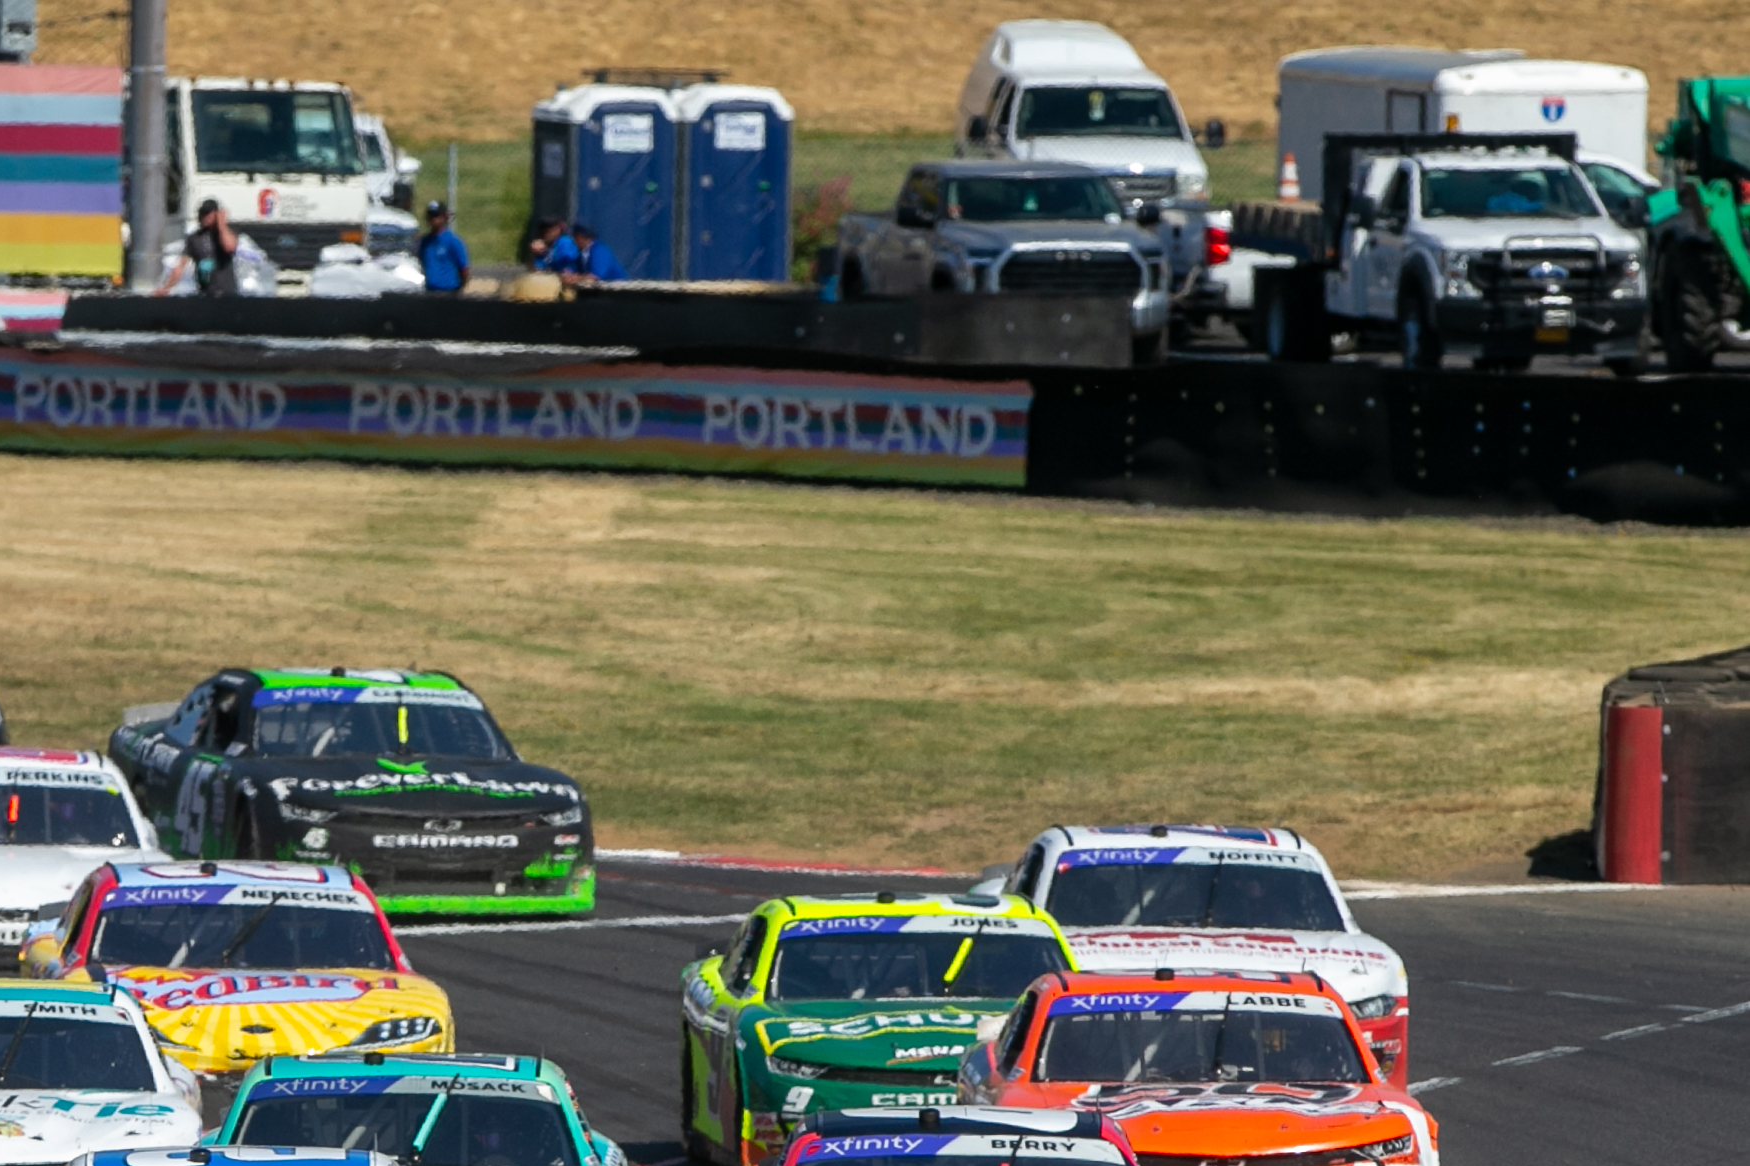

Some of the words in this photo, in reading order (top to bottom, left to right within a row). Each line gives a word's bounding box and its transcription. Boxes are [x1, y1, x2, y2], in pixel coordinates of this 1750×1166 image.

[14, 372, 286, 431] PORTLAND
[350, 381, 643, 441] PORTLAND
[703, 395, 997, 456] PORTLAND
[6, 771, 104, 786] PERKINS
[372, 834, 519, 849] CAMARO
[1078, 848, 1159, 864] xfinity
[1208, 851, 1300, 864] MOFFITT
[124, 886, 208, 903] xfinity
[241, 888, 359, 905] NEMECHEK
[800, 917, 886, 934] xfinity
[949, 918, 1018, 930] JONES
[22, 1002, 97, 1017] SMITH
[1071, 994, 1160, 1010] xfinity
[1227, 995, 1306, 1009] LABBE
[272, 1077, 369, 1095] xfinity
[430, 1079, 526, 1094] MOSACK
[782, 1086, 814, 1113] 9
[824, 1136, 923, 1156] xfinity
[990, 1138, 1077, 1153] BERRY
